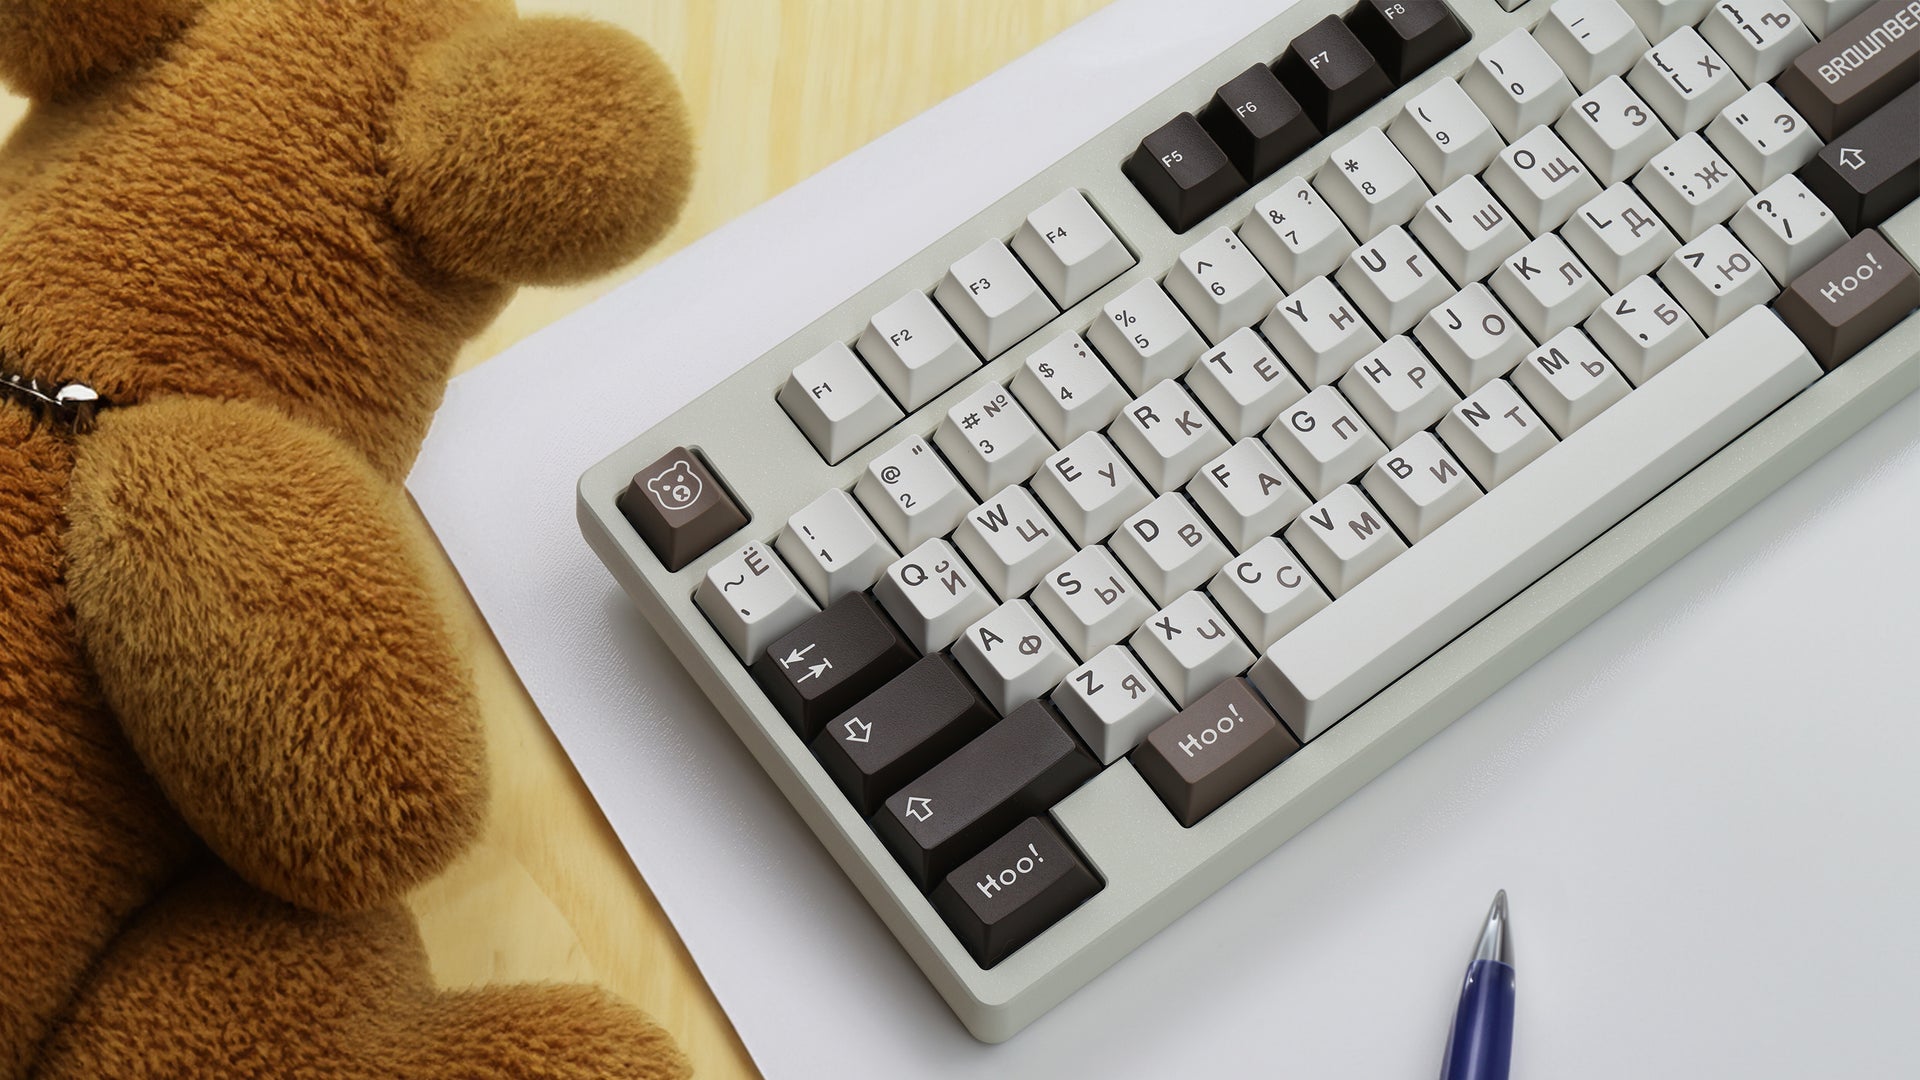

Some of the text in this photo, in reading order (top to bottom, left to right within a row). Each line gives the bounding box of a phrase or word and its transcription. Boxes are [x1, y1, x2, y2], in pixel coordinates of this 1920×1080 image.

[1384, 3, 1405, 21] F8
[1310, 51, 1330, 70] F7
[1236, 101, 1257, 118] F6
[1582, 101, 1600, 122] P
[1436, 131, 1450, 144] 9
[1162, 150, 1183, 168] F5
[1361, 182, 1376, 195] 8
[1269, 210, 1286, 224] &
[1586, 212, 1612, 229] L
[1045, 227, 1067, 244] F4
[1285, 230, 1298, 245] 7
[1360, 249, 1386, 272] U
[1513, 257, 1541, 280] K
[969, 278, 991, 295] F3
[1820, 253, 1883, 303] Hoo!
[1211, 282, 1225, 296] 6
[1115, 310, 1136, 327] %
[1285, 300, 1308, 322] Y
[1446, 308, 1462, 330] J
[890, 329, 912, 346] F2
[1135, 334, 1149, 348] 5
[1039, 363, 1054, 378] $
[1210, 351, 1233, 374] T
[1363, 358, 1391, 383] H
[1537, 348, 1570, 375] M
[812, 383, 832, 399] F1
[1061, 386, 1073, 400] 4
[961, 413, 980, 429] #
[1133, 406, 1160, 429] R
[1291, 411, 1315, 432] G
[1461, 402, 1490, 427] N
[979, 440, 994, 454] 3
[881, 466, 901, 484] @
[1055, 457, 1082, 482] E
[1211, 464, 1230, 488] F
[1387, 457, 1413, 479] B
[900, 493, 916, 508] 2
[977, 504, 1008, 532] W
[1309, 508, 1334, 530] V
[803, 526, 815, 540] !
[1133, 519, 1159, 542] D
[820, 549, 832, 562] 1
[901, 564, 928, 586] Q
[1057, 572, 1081, 595] S
[1237, 562, 1261, 584] C
[979, 627, 1004, 651] A
[1155, 617, 1182, 640] X
[1076, 670, 1104, 696] Z
[1178, 704, 1245, 757] Hoo!
[976, 843, 1044, 899] Hoo!
